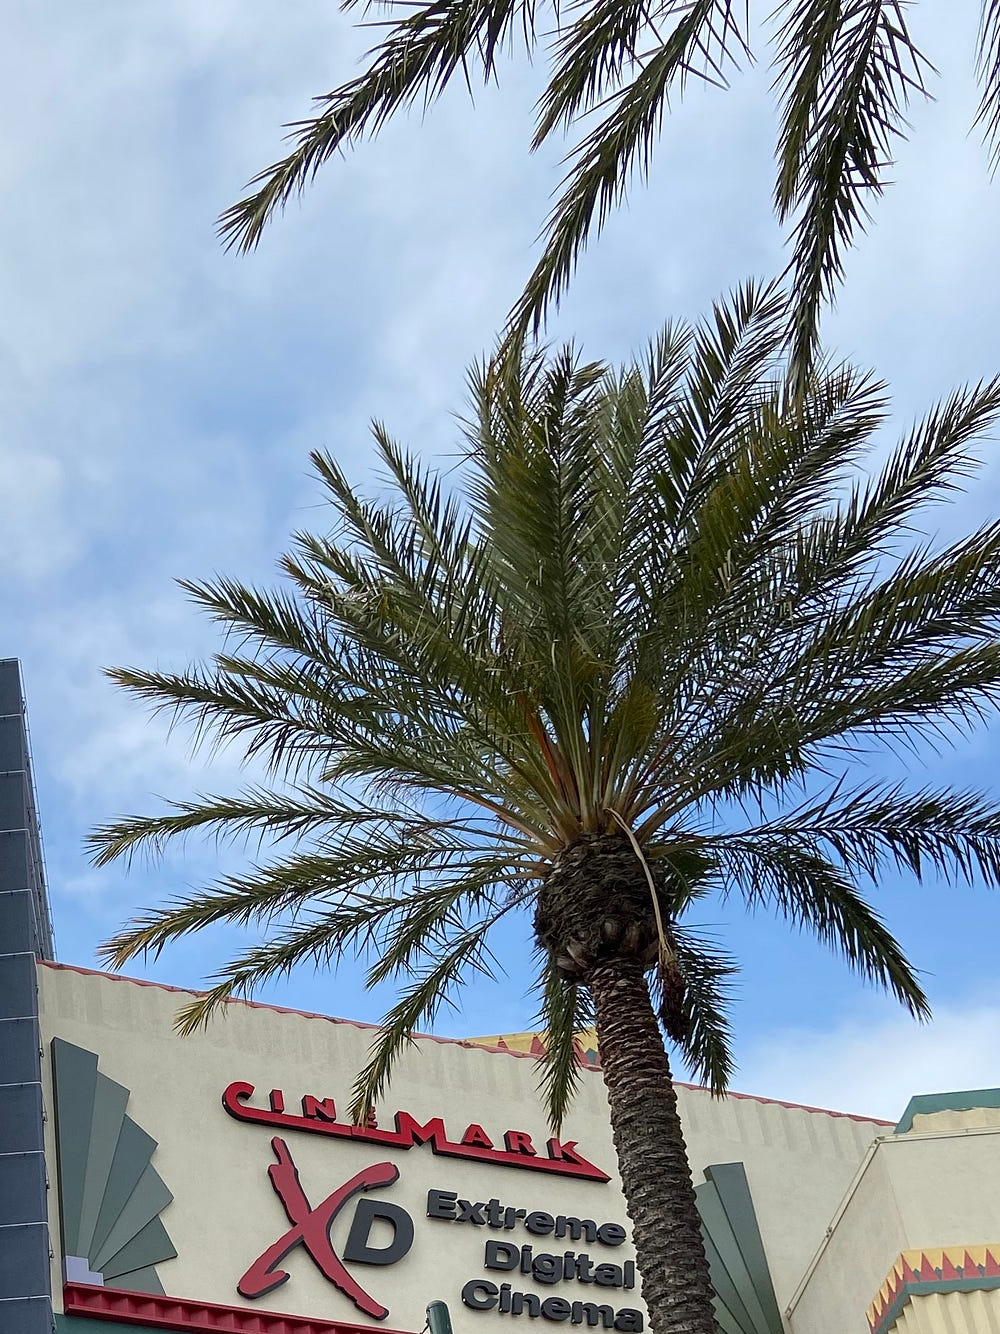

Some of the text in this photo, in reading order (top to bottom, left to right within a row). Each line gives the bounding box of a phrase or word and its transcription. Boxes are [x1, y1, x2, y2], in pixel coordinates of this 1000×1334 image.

[237, 1136, 415, 1320] XD
[426, 1188, 627, 1247] Extreme
[484, 1239, 635, 1290] Digital
[461, 1279, 644, 1334] Cinema
